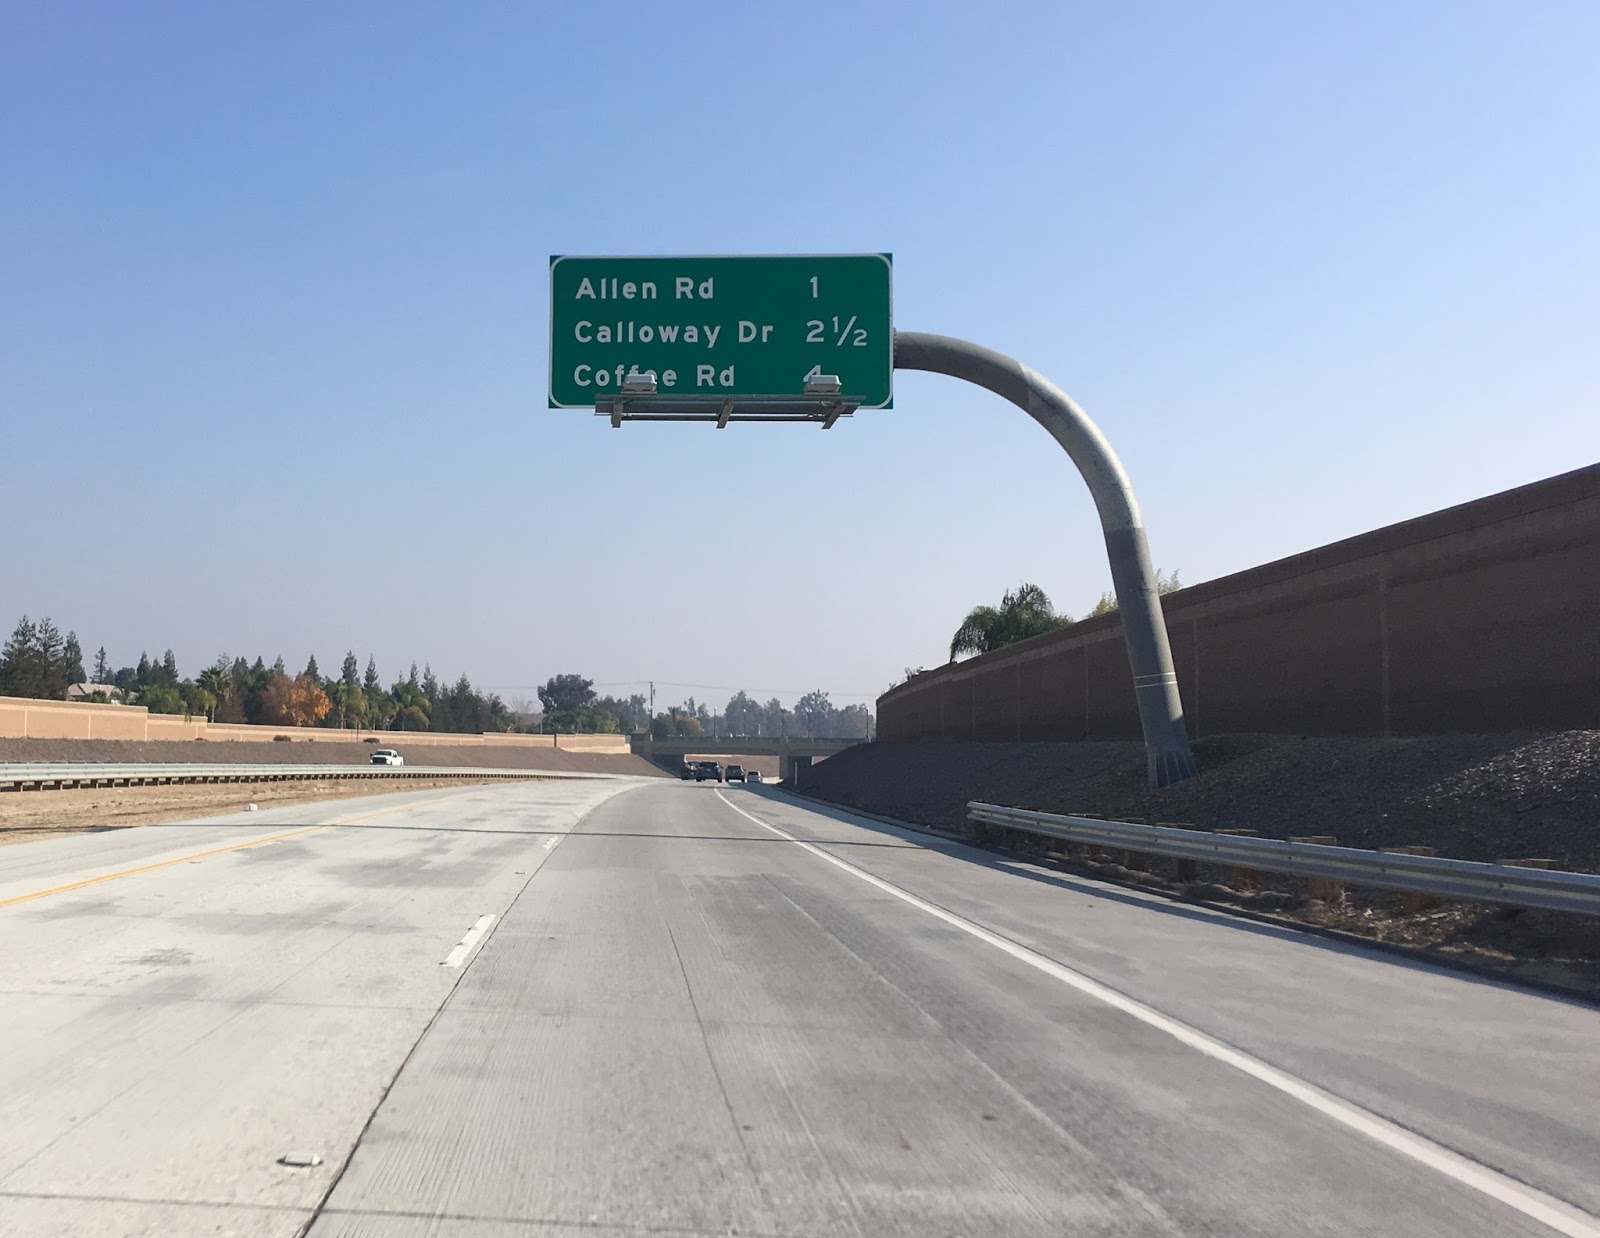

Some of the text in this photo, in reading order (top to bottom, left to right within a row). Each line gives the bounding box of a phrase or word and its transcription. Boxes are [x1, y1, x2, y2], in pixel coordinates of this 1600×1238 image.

[575, 276, 819, 300] Allen Rd 1
[574, 320, 722, 349] Calloway
[737, 321, 774, 343] Dr
[696, 364, 735, 387] Rd
